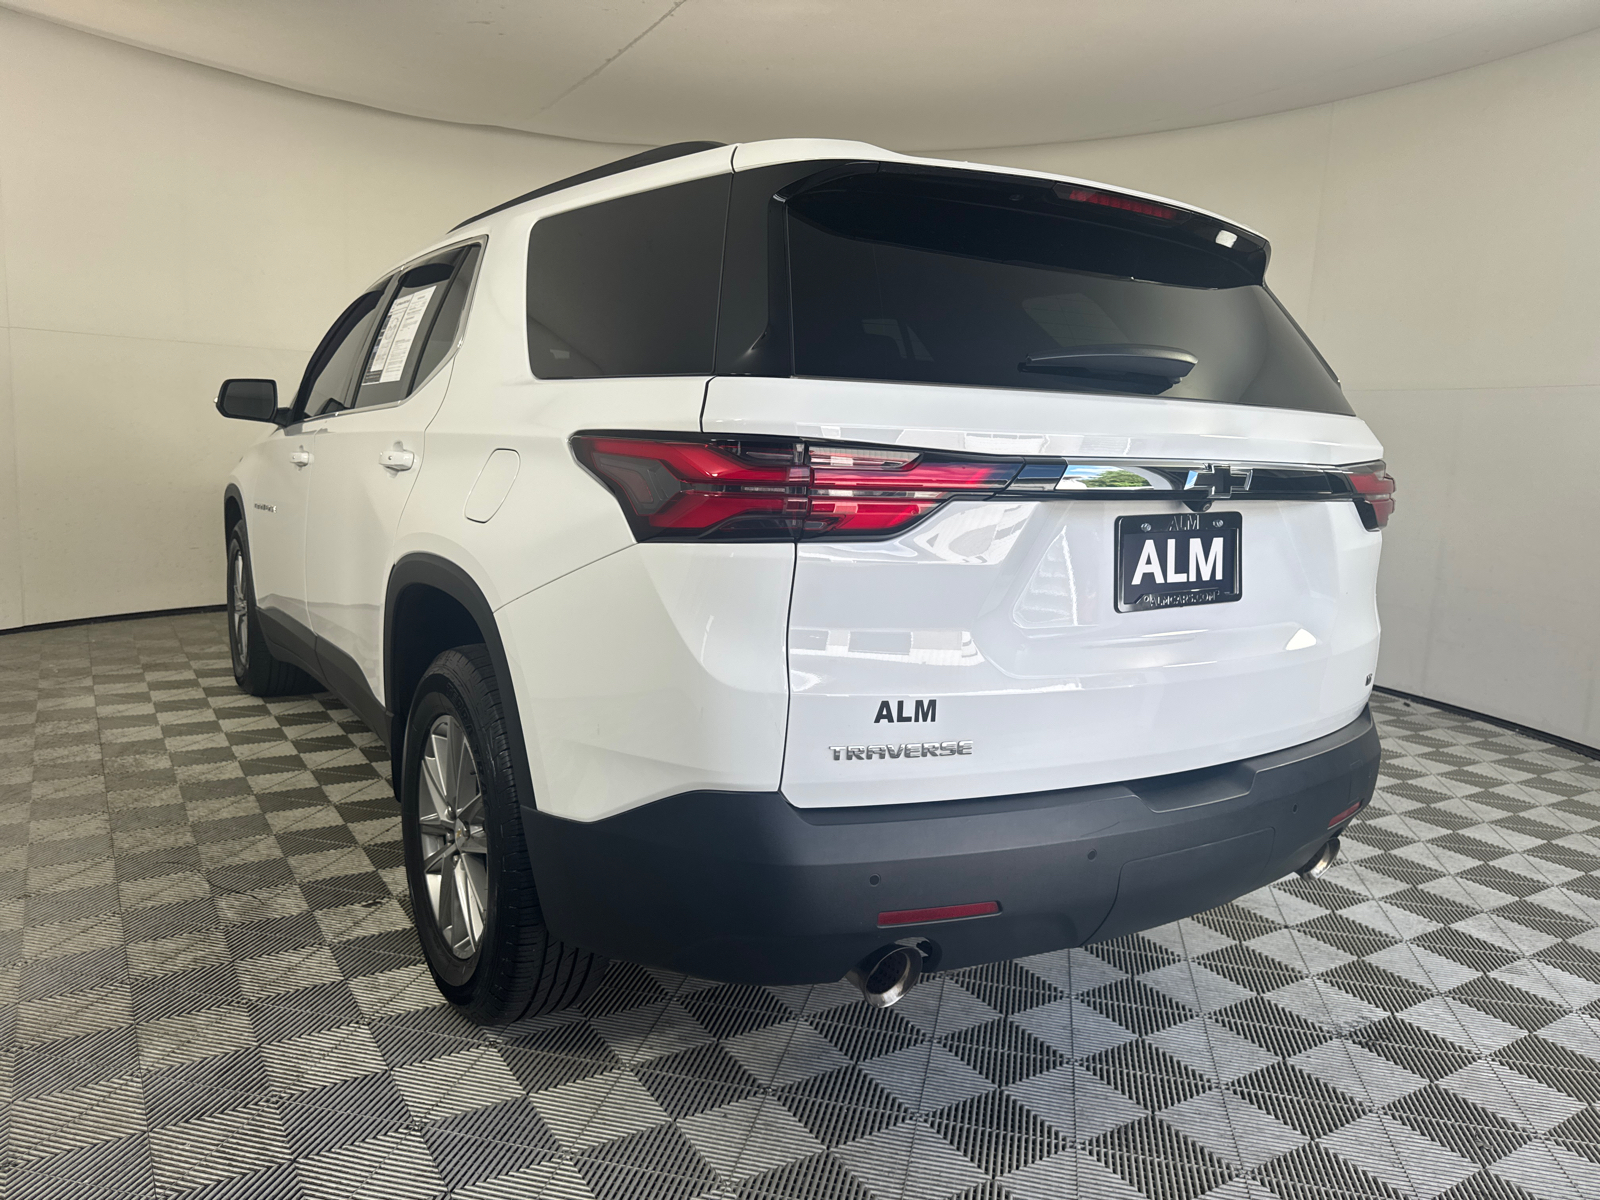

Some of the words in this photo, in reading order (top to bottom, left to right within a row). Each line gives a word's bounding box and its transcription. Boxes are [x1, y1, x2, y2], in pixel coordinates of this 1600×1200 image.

[1167, 513, 1200, 531] ALM
[1131, 537, 1224, 585] ALM
[873, 699, 937, 723] ALM
[829, 740, 974, 761] TRAVERSE
